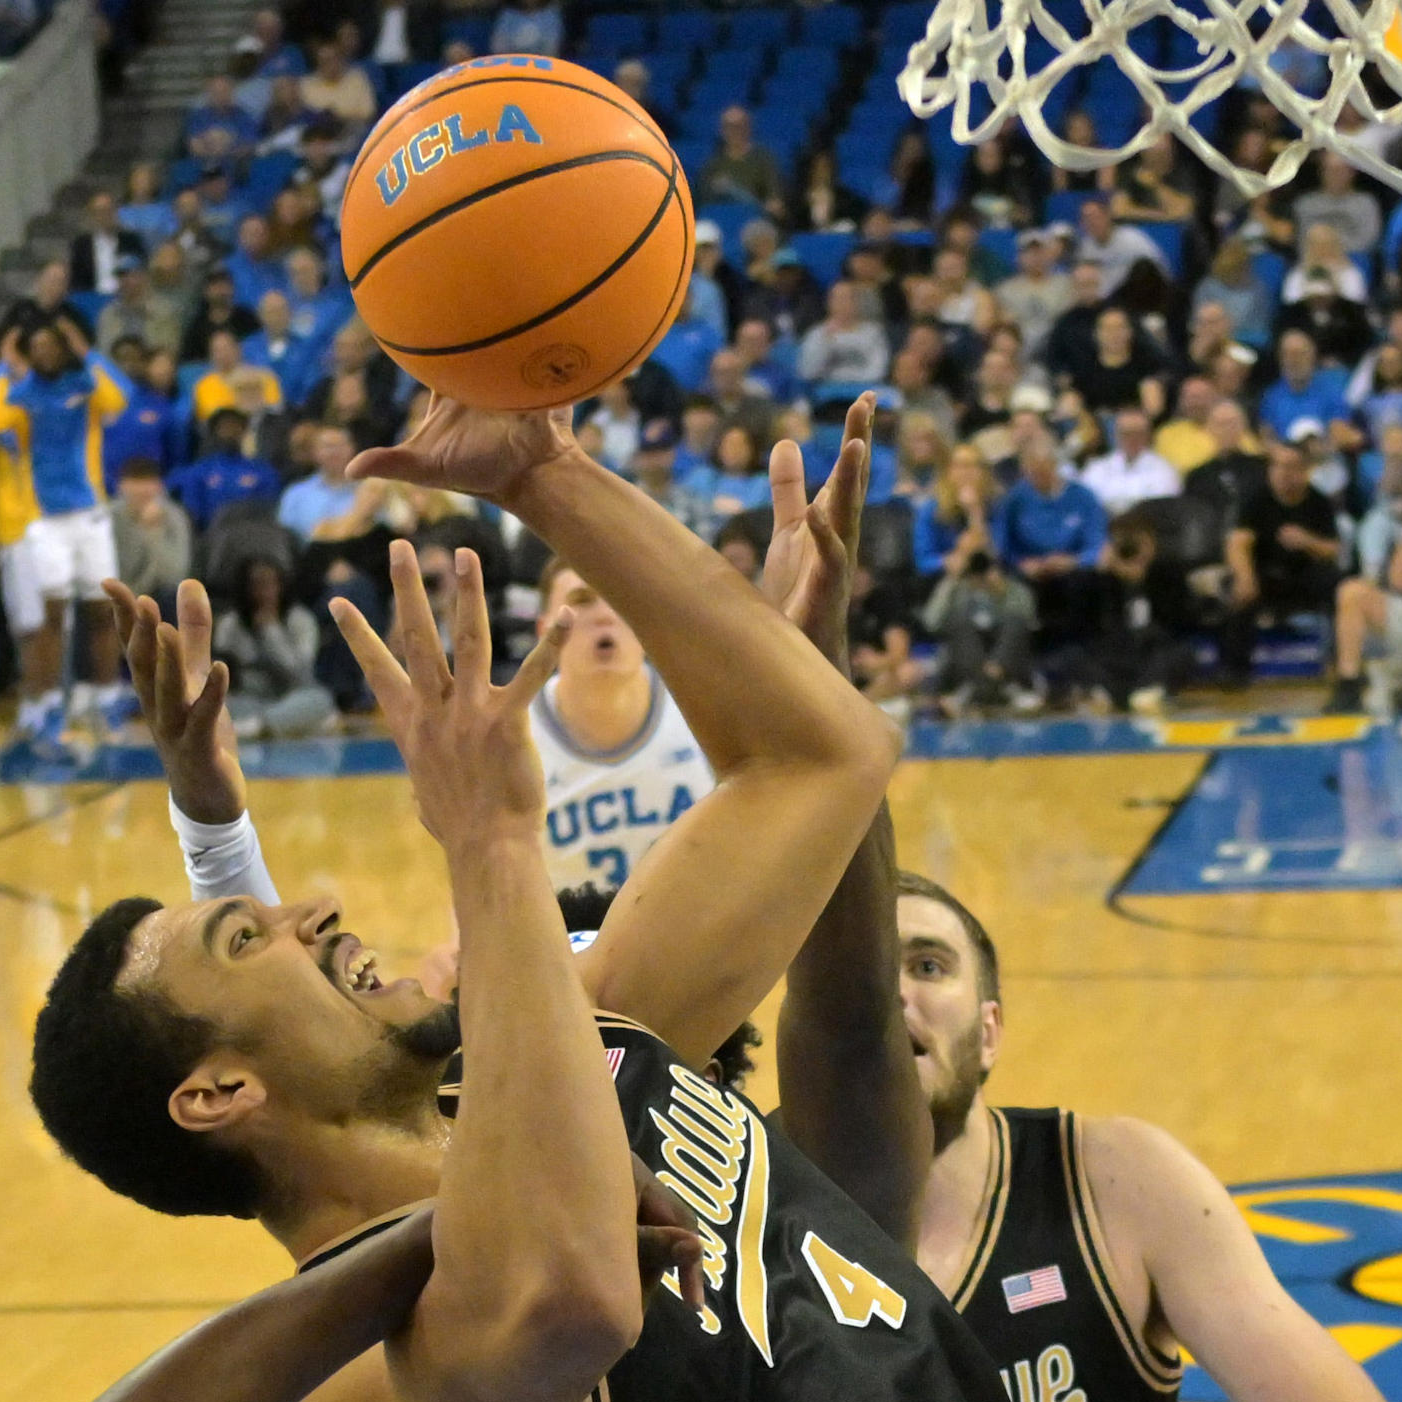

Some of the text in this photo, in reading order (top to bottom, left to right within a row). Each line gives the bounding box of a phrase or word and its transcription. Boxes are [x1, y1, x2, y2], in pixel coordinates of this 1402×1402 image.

[375, 104, 544, 207] UCLA
[546, 784, 695, 848] UCLA
[801, 1230, 907, 1329] 4
